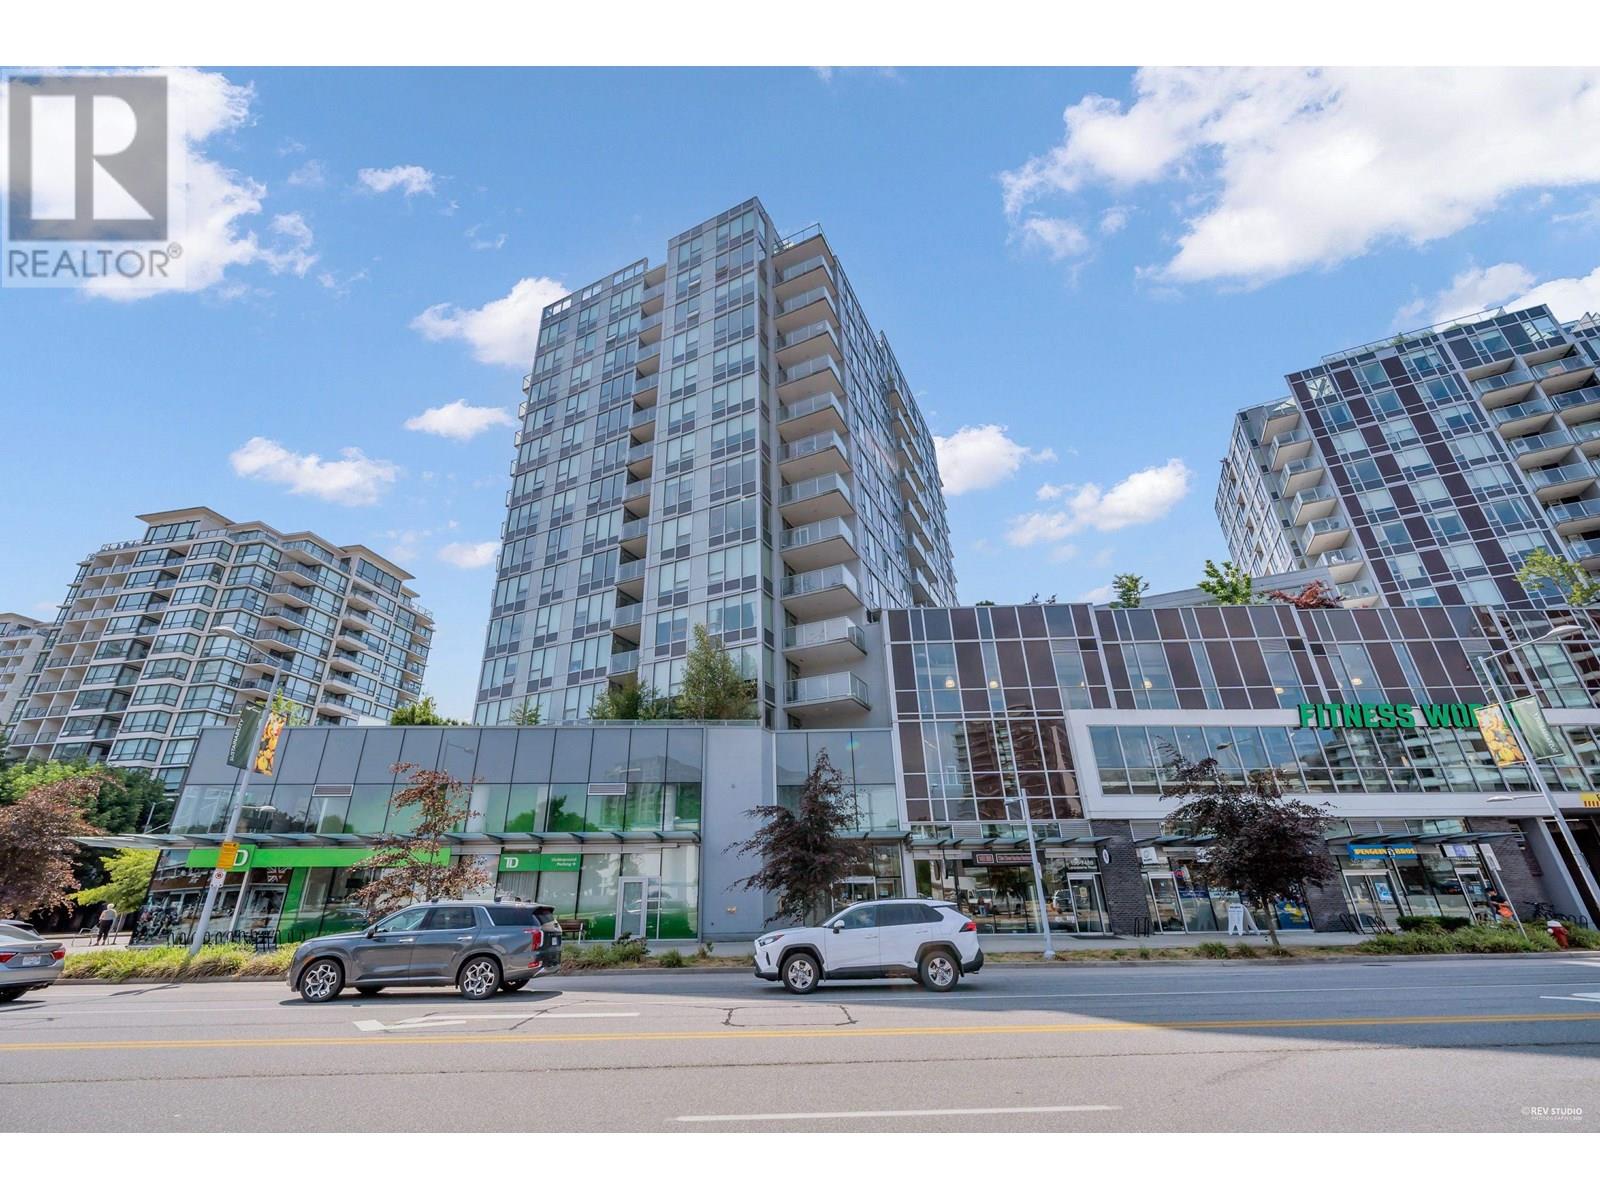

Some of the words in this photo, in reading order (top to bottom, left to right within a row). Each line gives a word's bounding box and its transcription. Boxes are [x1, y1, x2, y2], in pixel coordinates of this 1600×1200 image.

[1299, 703, 1416, 729] FITNESS
[232, 849, 249, 867] D
[504, 857, 519, 869] TD
